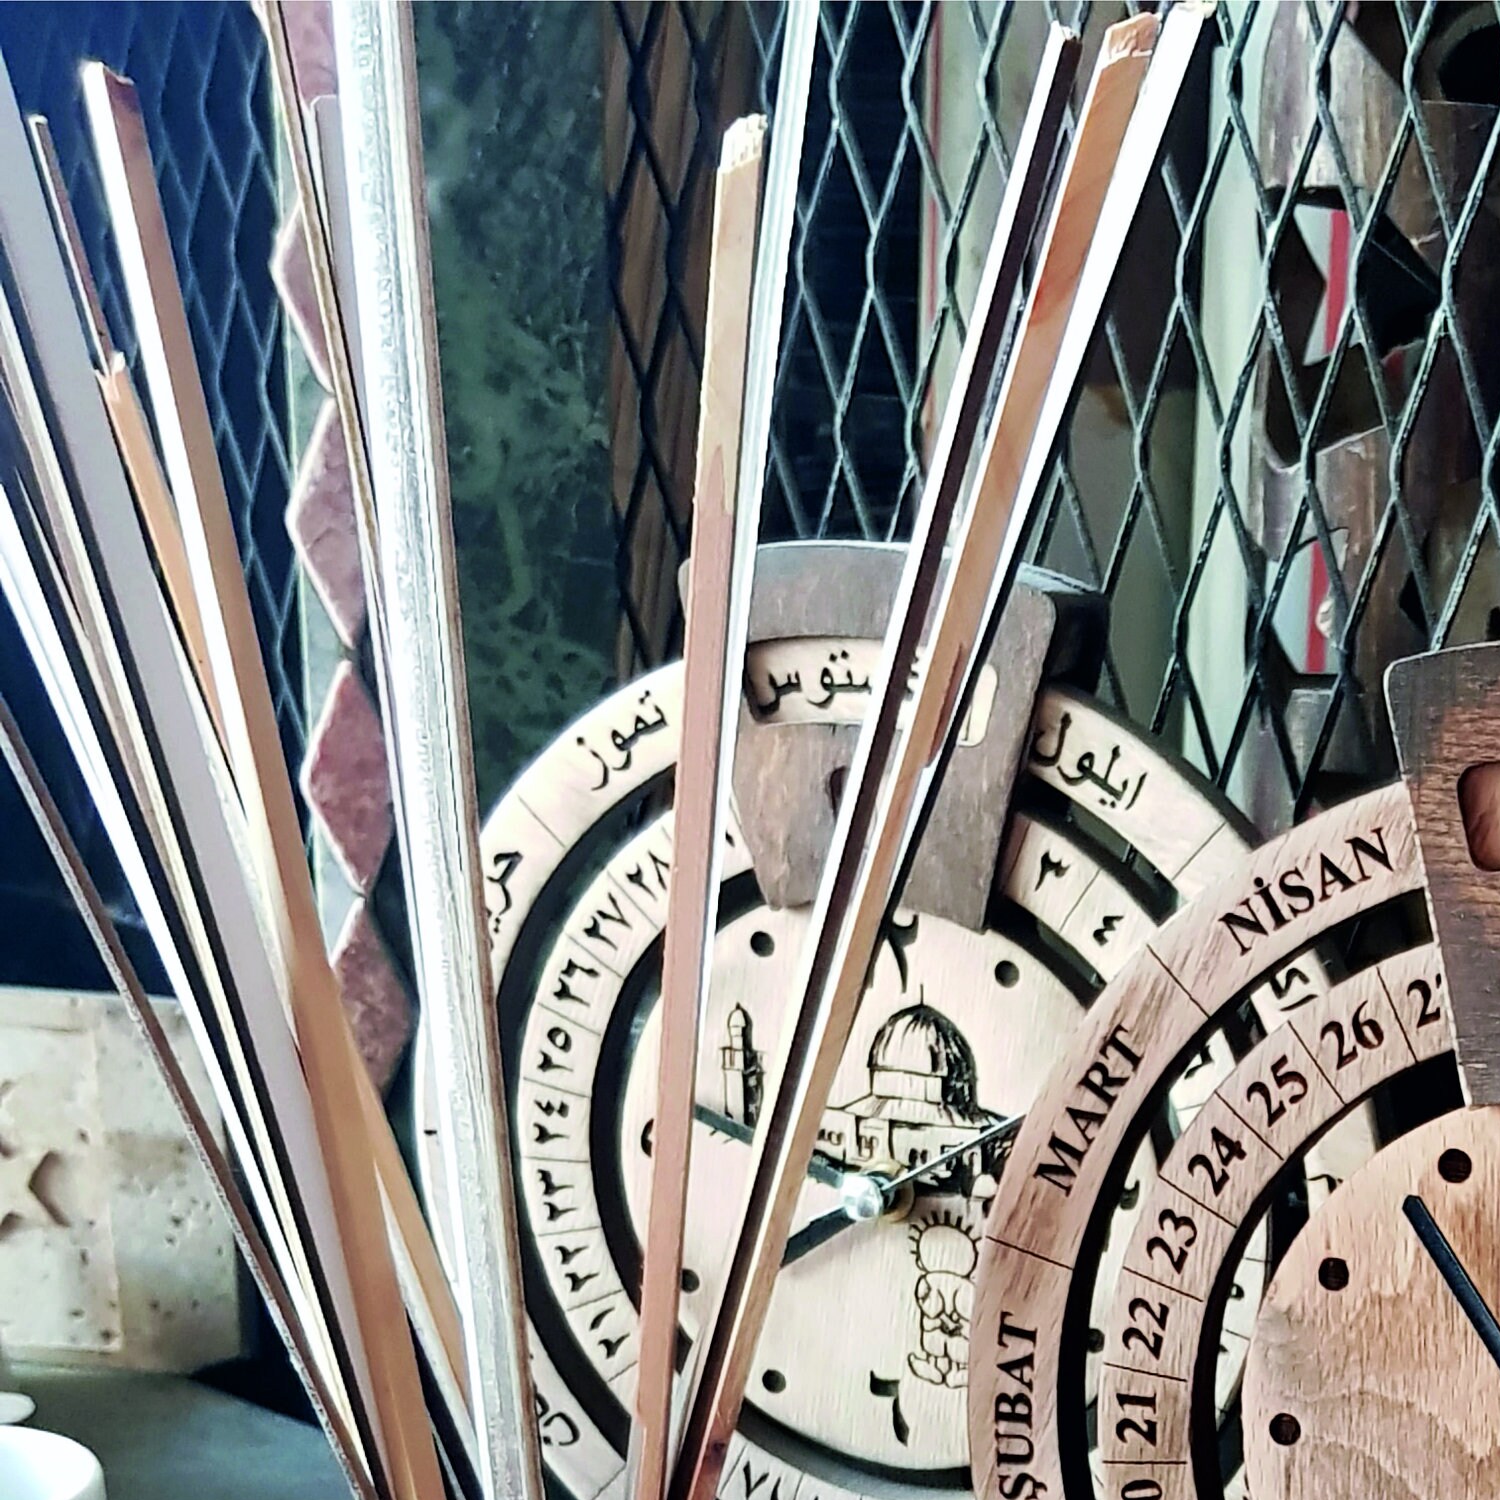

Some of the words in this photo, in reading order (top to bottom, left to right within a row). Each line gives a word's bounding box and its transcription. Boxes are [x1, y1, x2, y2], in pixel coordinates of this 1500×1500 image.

[576, 690, 670, 791] تموز
[583, 891, 633, 952] ٢٧
[1218, 827, 1395, 957] NİSAN
[552, 957, 600, 1007] ٢٦
[1406, 972, 1442, 1030] 2
[536, 1025, 575, 1073] ٢٥
[1320, 1000, 1386, 1071] 26
[533, 1099, 570, 1144] ٢٤
[1033, 1023, 1145, 1199] MART
[1246, 1054, 1309, 1129] 25
[1187, 1126, 1248, 1198] 24
[1145, 1207, 1198, 1275] 23
[1121, 1296, 1171, 1361] 22
[1115, 1390, 1158, 1448] 21
